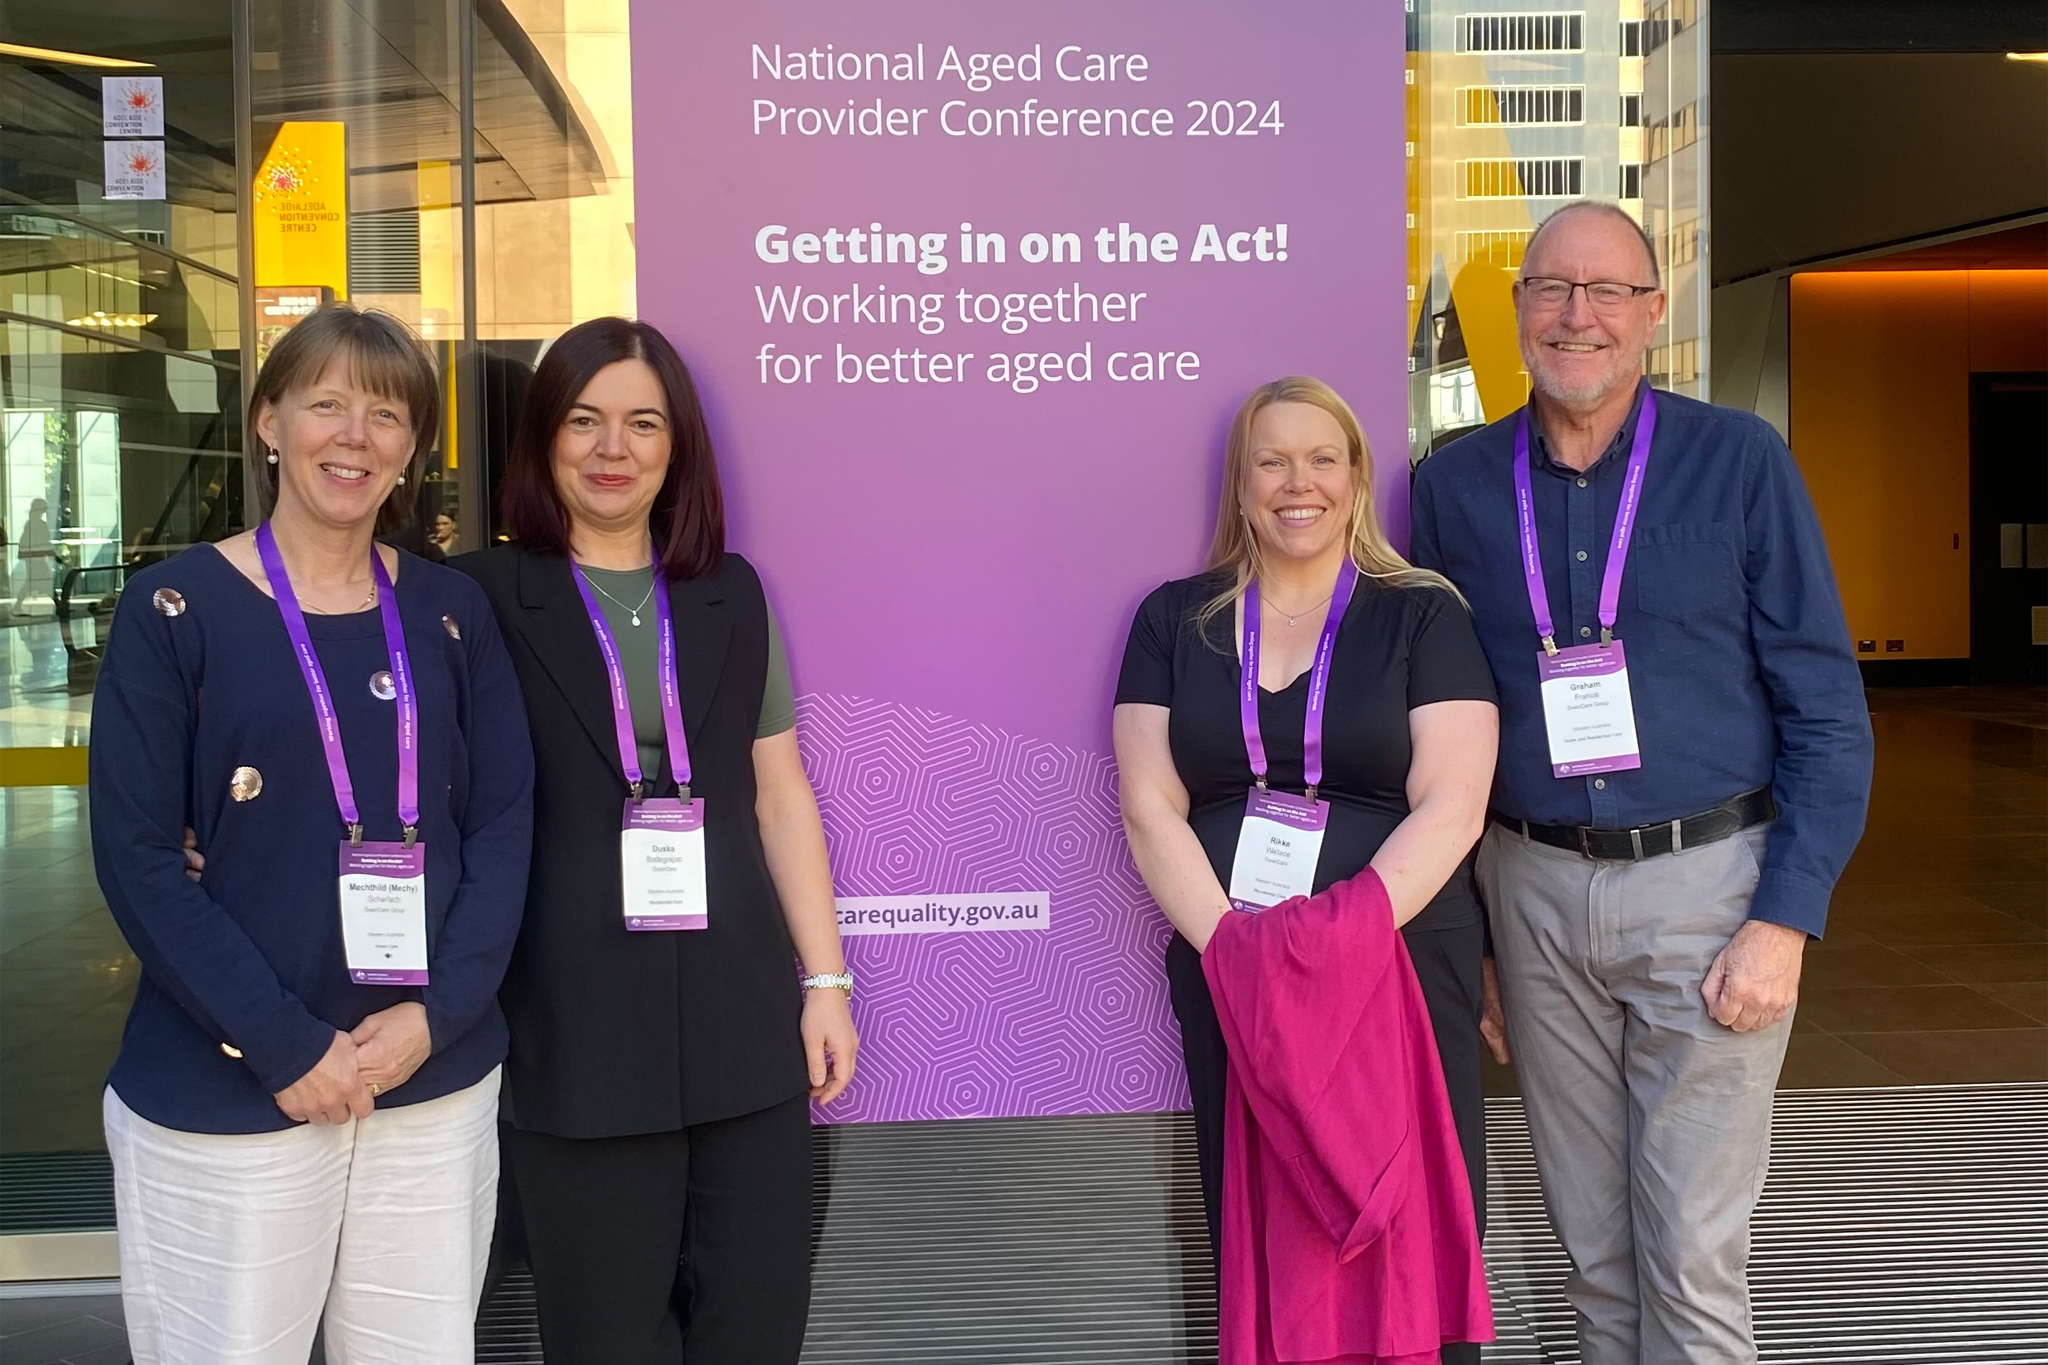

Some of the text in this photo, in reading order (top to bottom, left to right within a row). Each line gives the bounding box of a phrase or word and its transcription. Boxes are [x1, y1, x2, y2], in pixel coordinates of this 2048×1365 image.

[753, 44, 1148, 91] National Aged Care
[754, 99, 1284, 136] Provider Conference 2024
[756, 223, 1287, 274] Getting in on the Act!
[755, 283, 1146, 334] Working together
[756, 342, 1199, 393] for better aged care
[1631, 466, 1640, 483] Working
[598, 630, 607, 641] aged
[604, 642, 612, 656] better
[304, 655, 313, 666] aged
[310, 668, 319, 684] better
[1570, 681, 1601, 691] Graham
[1574, 692, 1600, 701] Francis
[326, 717, 334, 742] Working
[652, 845, 675, 853] Duska
[1270, 836, 1291, 848] Rikke
[1266, 846, 1291, 858] Wallace
[349, 883, 419, 894] Mechthild (Mechy)
